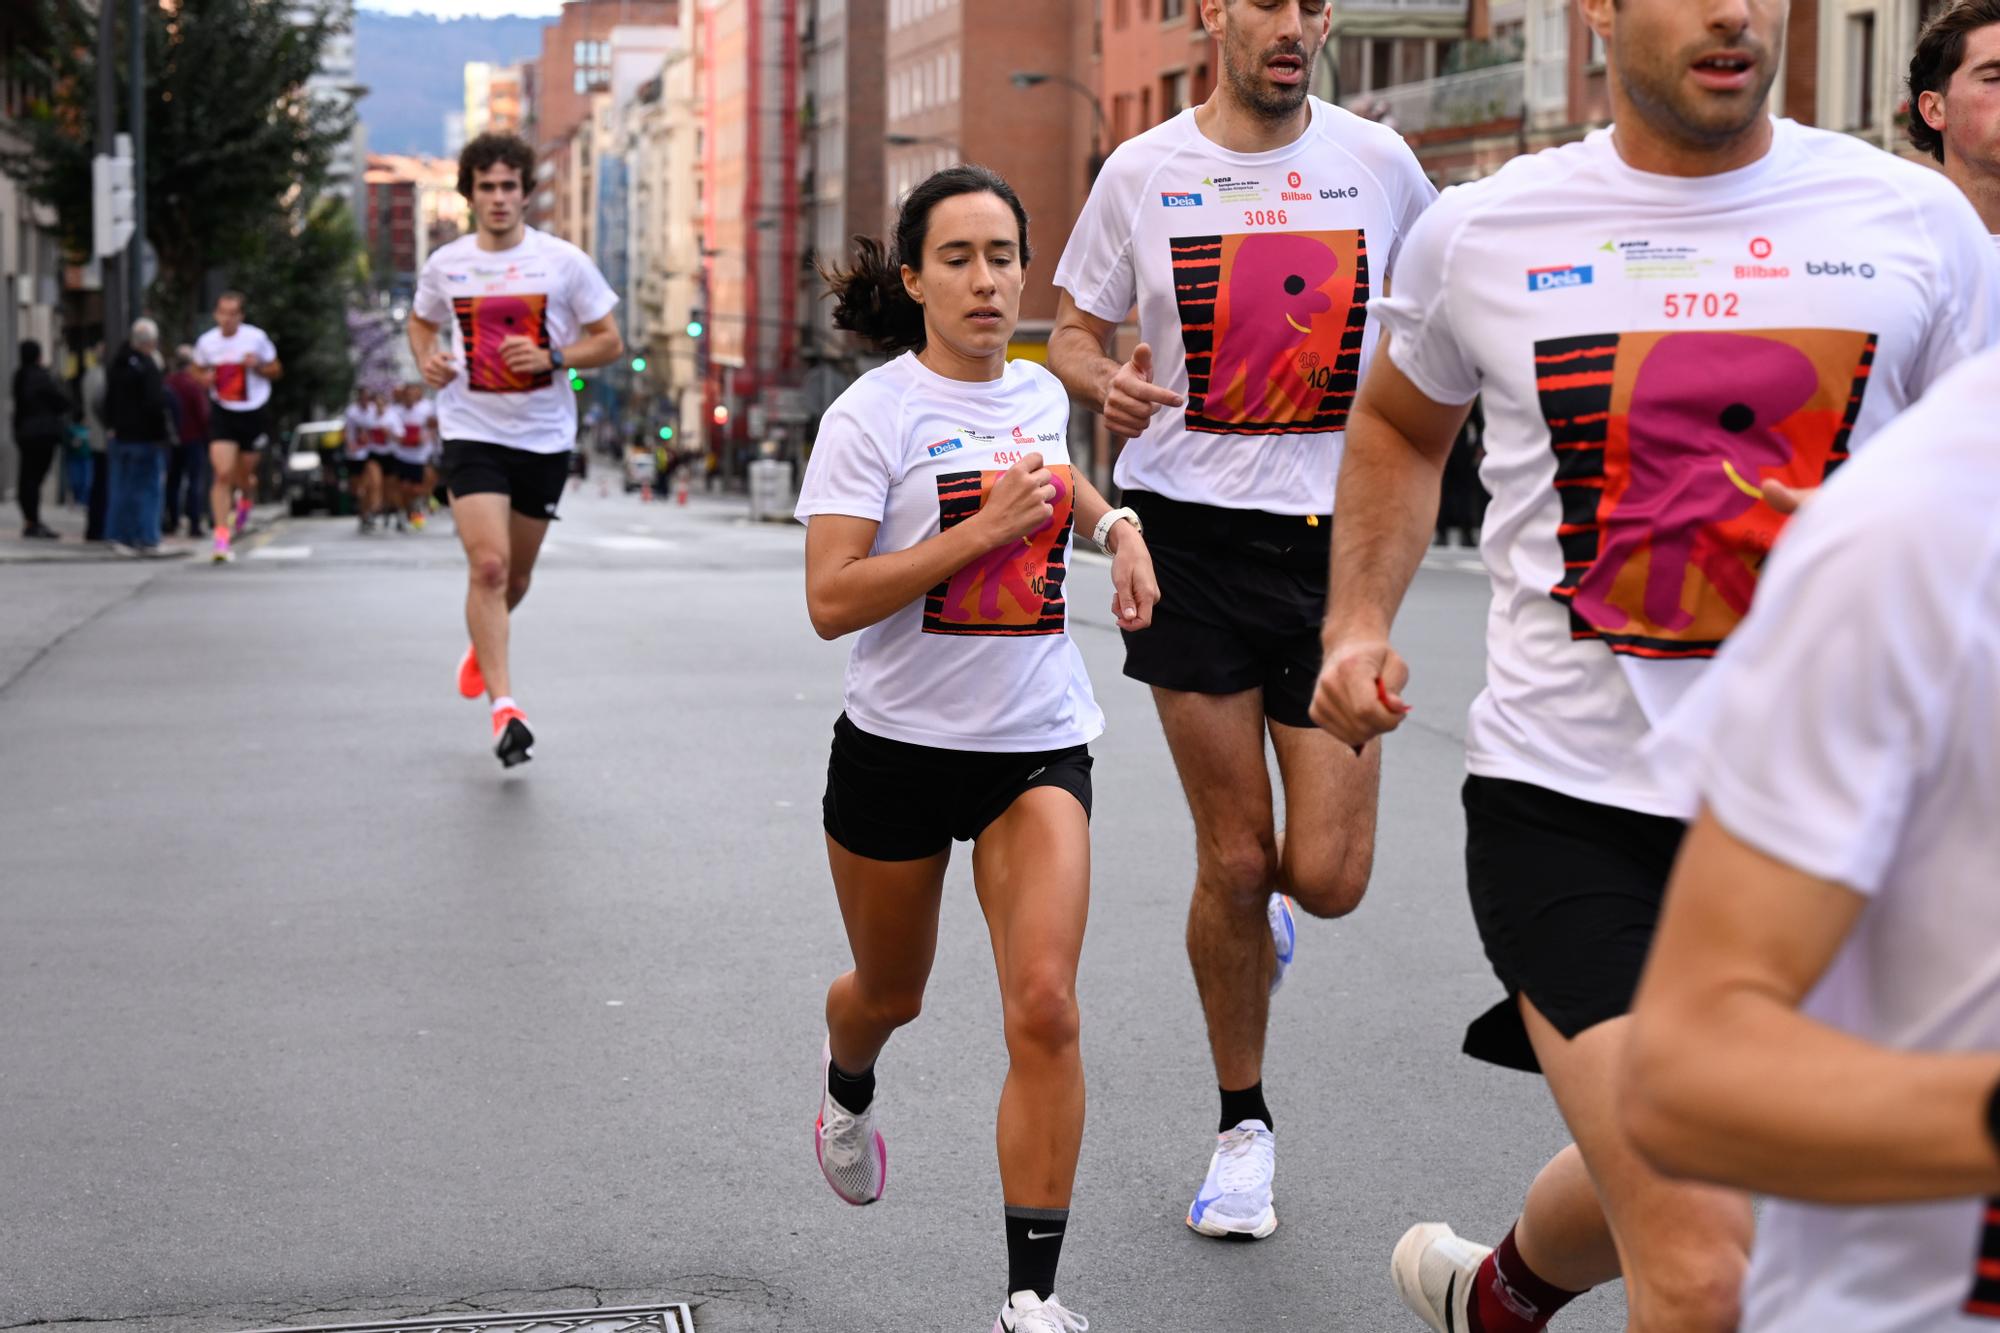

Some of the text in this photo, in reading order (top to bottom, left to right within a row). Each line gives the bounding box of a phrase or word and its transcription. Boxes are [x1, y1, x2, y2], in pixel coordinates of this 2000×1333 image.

[1213, 176, 1231, 184] aena
[1168, 196, 1196, 207] Deia
[1281, 191, 1312, 201] Bilbao
[1319, 188, 1347, 200] bbk
[1244, 209, 1288, 226] 3086
[1734, 265, 1790, 279] Bilbao
[1806, 261, 1855, 277] bbk
[1536, 271, 1582, 291] Deia
[1664, 292, 1739, 318] 5702
[1308, 366, 1330, 388] 10
[934, 441, 957, 455] Deia
[1031, 575, 1045, 595] 10
